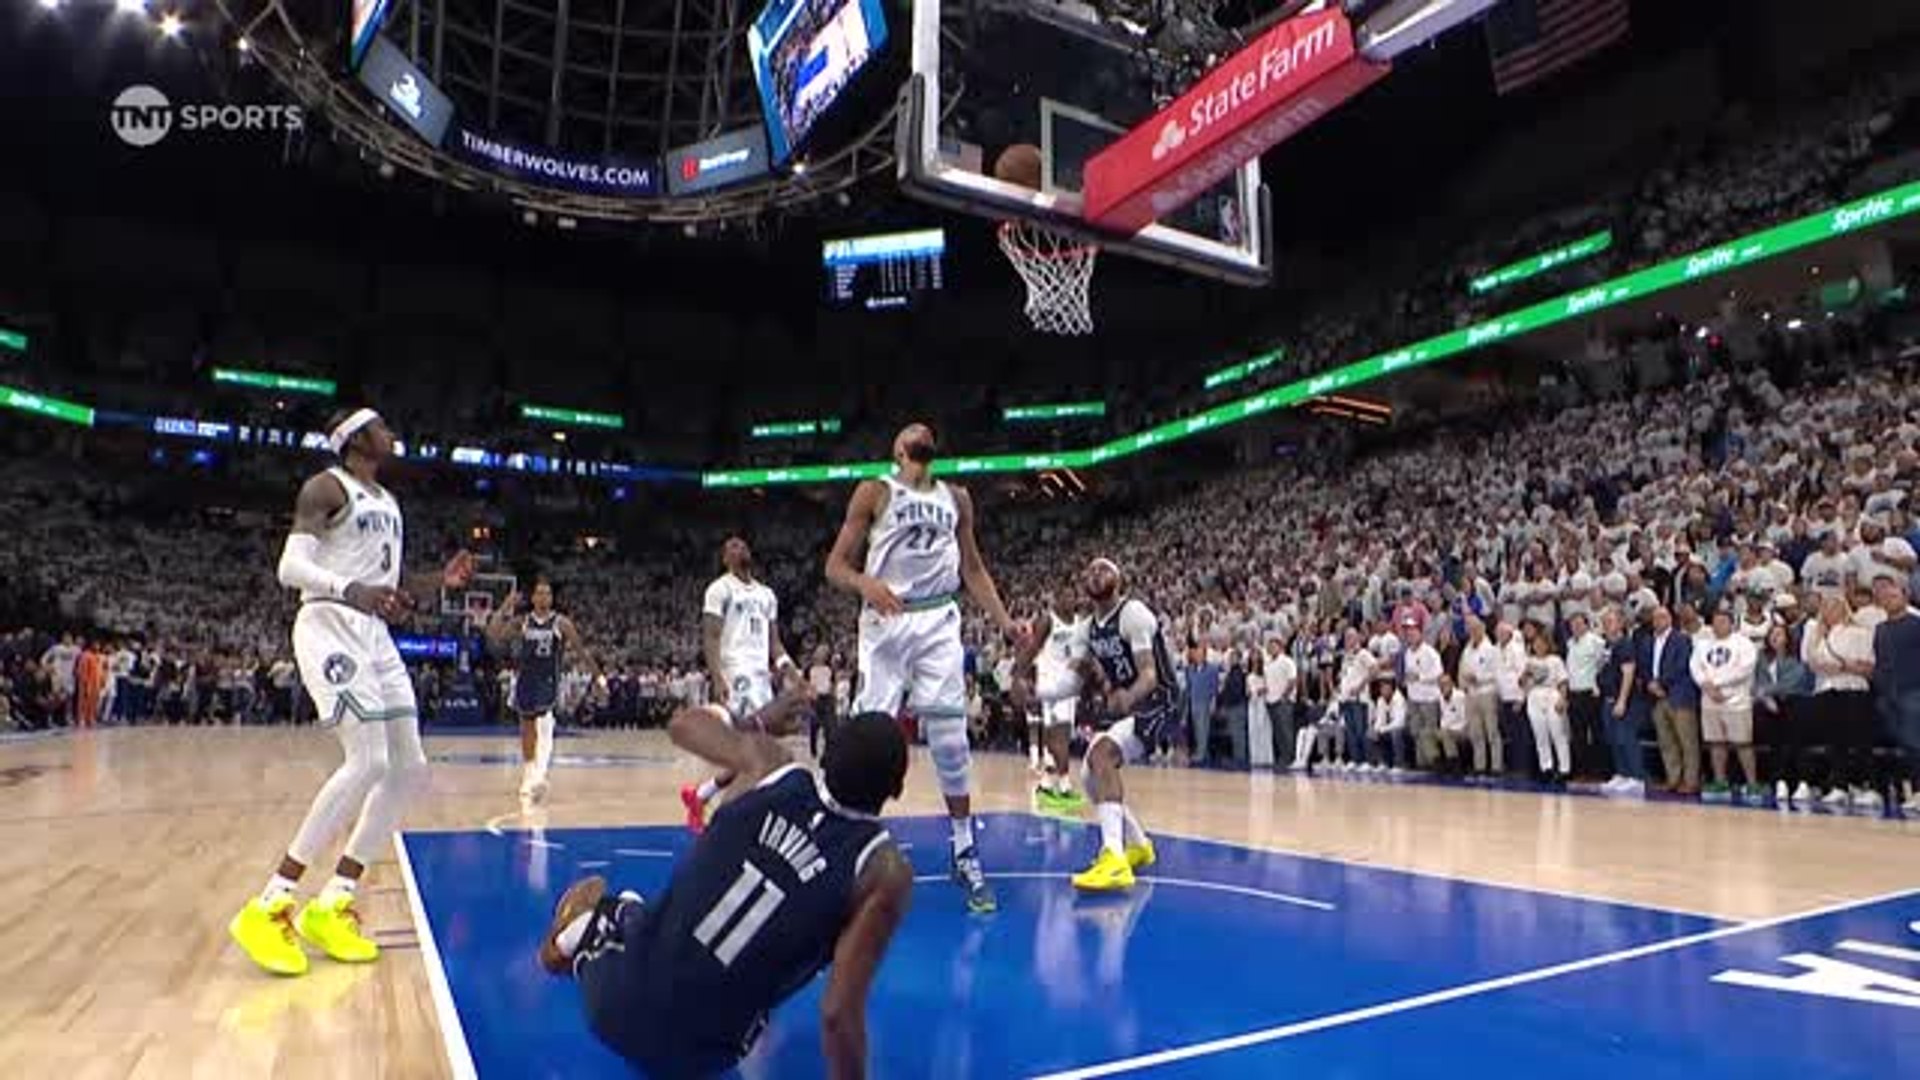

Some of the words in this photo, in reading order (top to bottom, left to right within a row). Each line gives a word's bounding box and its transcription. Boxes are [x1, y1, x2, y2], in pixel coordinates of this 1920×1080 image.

[461, 129, 650, 186] TIMBERWOLVES.COM
[1831, 196, 1895, 232] Sprite
[1684, 246, 1737, 278] Sprite
[906, 524, 938, 551] 27
[380, 541, 392, 574] 3
[759, 810, 828, 884] IRVING
[693, 859, 786, 968] 11
